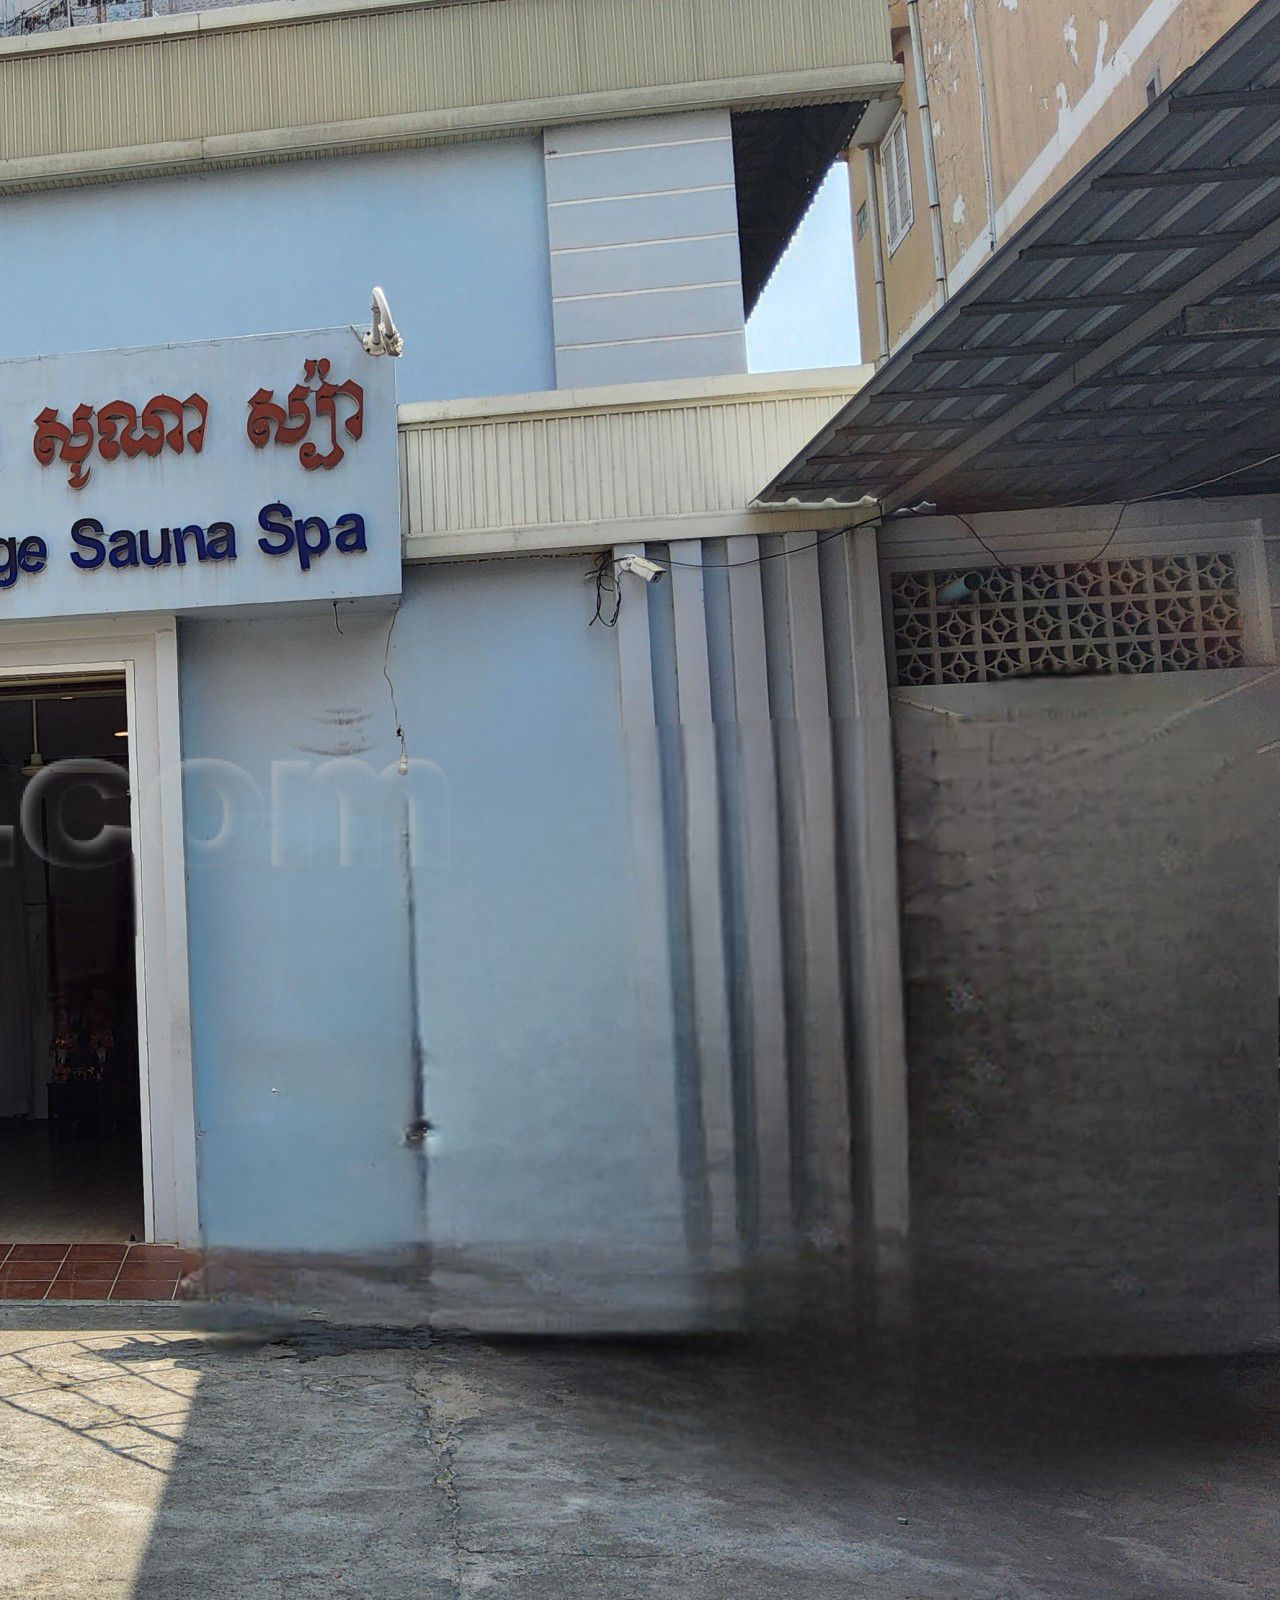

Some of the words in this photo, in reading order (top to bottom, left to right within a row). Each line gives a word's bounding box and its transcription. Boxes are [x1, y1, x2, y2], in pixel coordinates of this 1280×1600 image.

[33, 393, 208, 490] សូណា
[70, 517, 237, 571] Sauna
[258, 500, 368, 573] Spa
